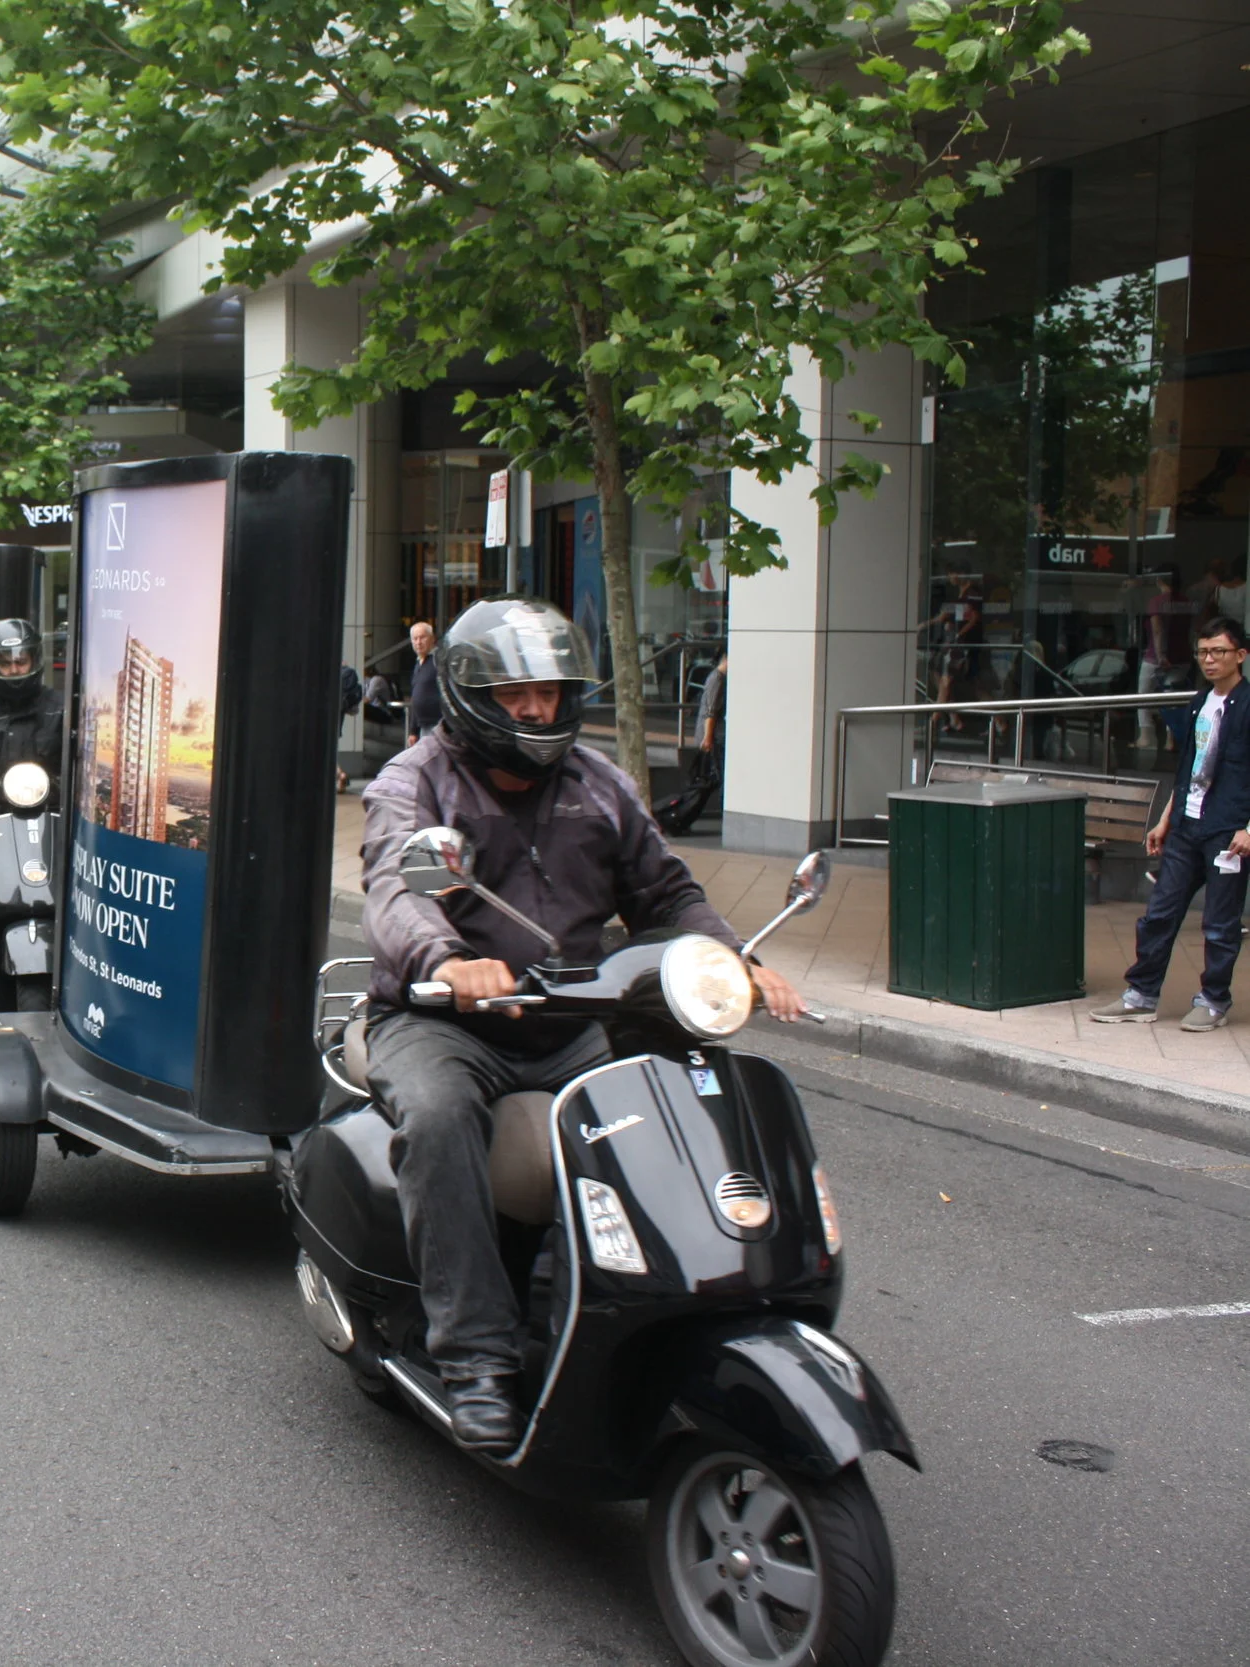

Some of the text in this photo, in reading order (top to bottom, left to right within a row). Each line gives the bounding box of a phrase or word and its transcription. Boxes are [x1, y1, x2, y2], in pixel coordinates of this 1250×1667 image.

[109, 862, 176, 911] SUITE
[96, 902, 150, 950] OPEN
[100, 961, 110, 980] St
[111, 966, 163, 999] Leonards
